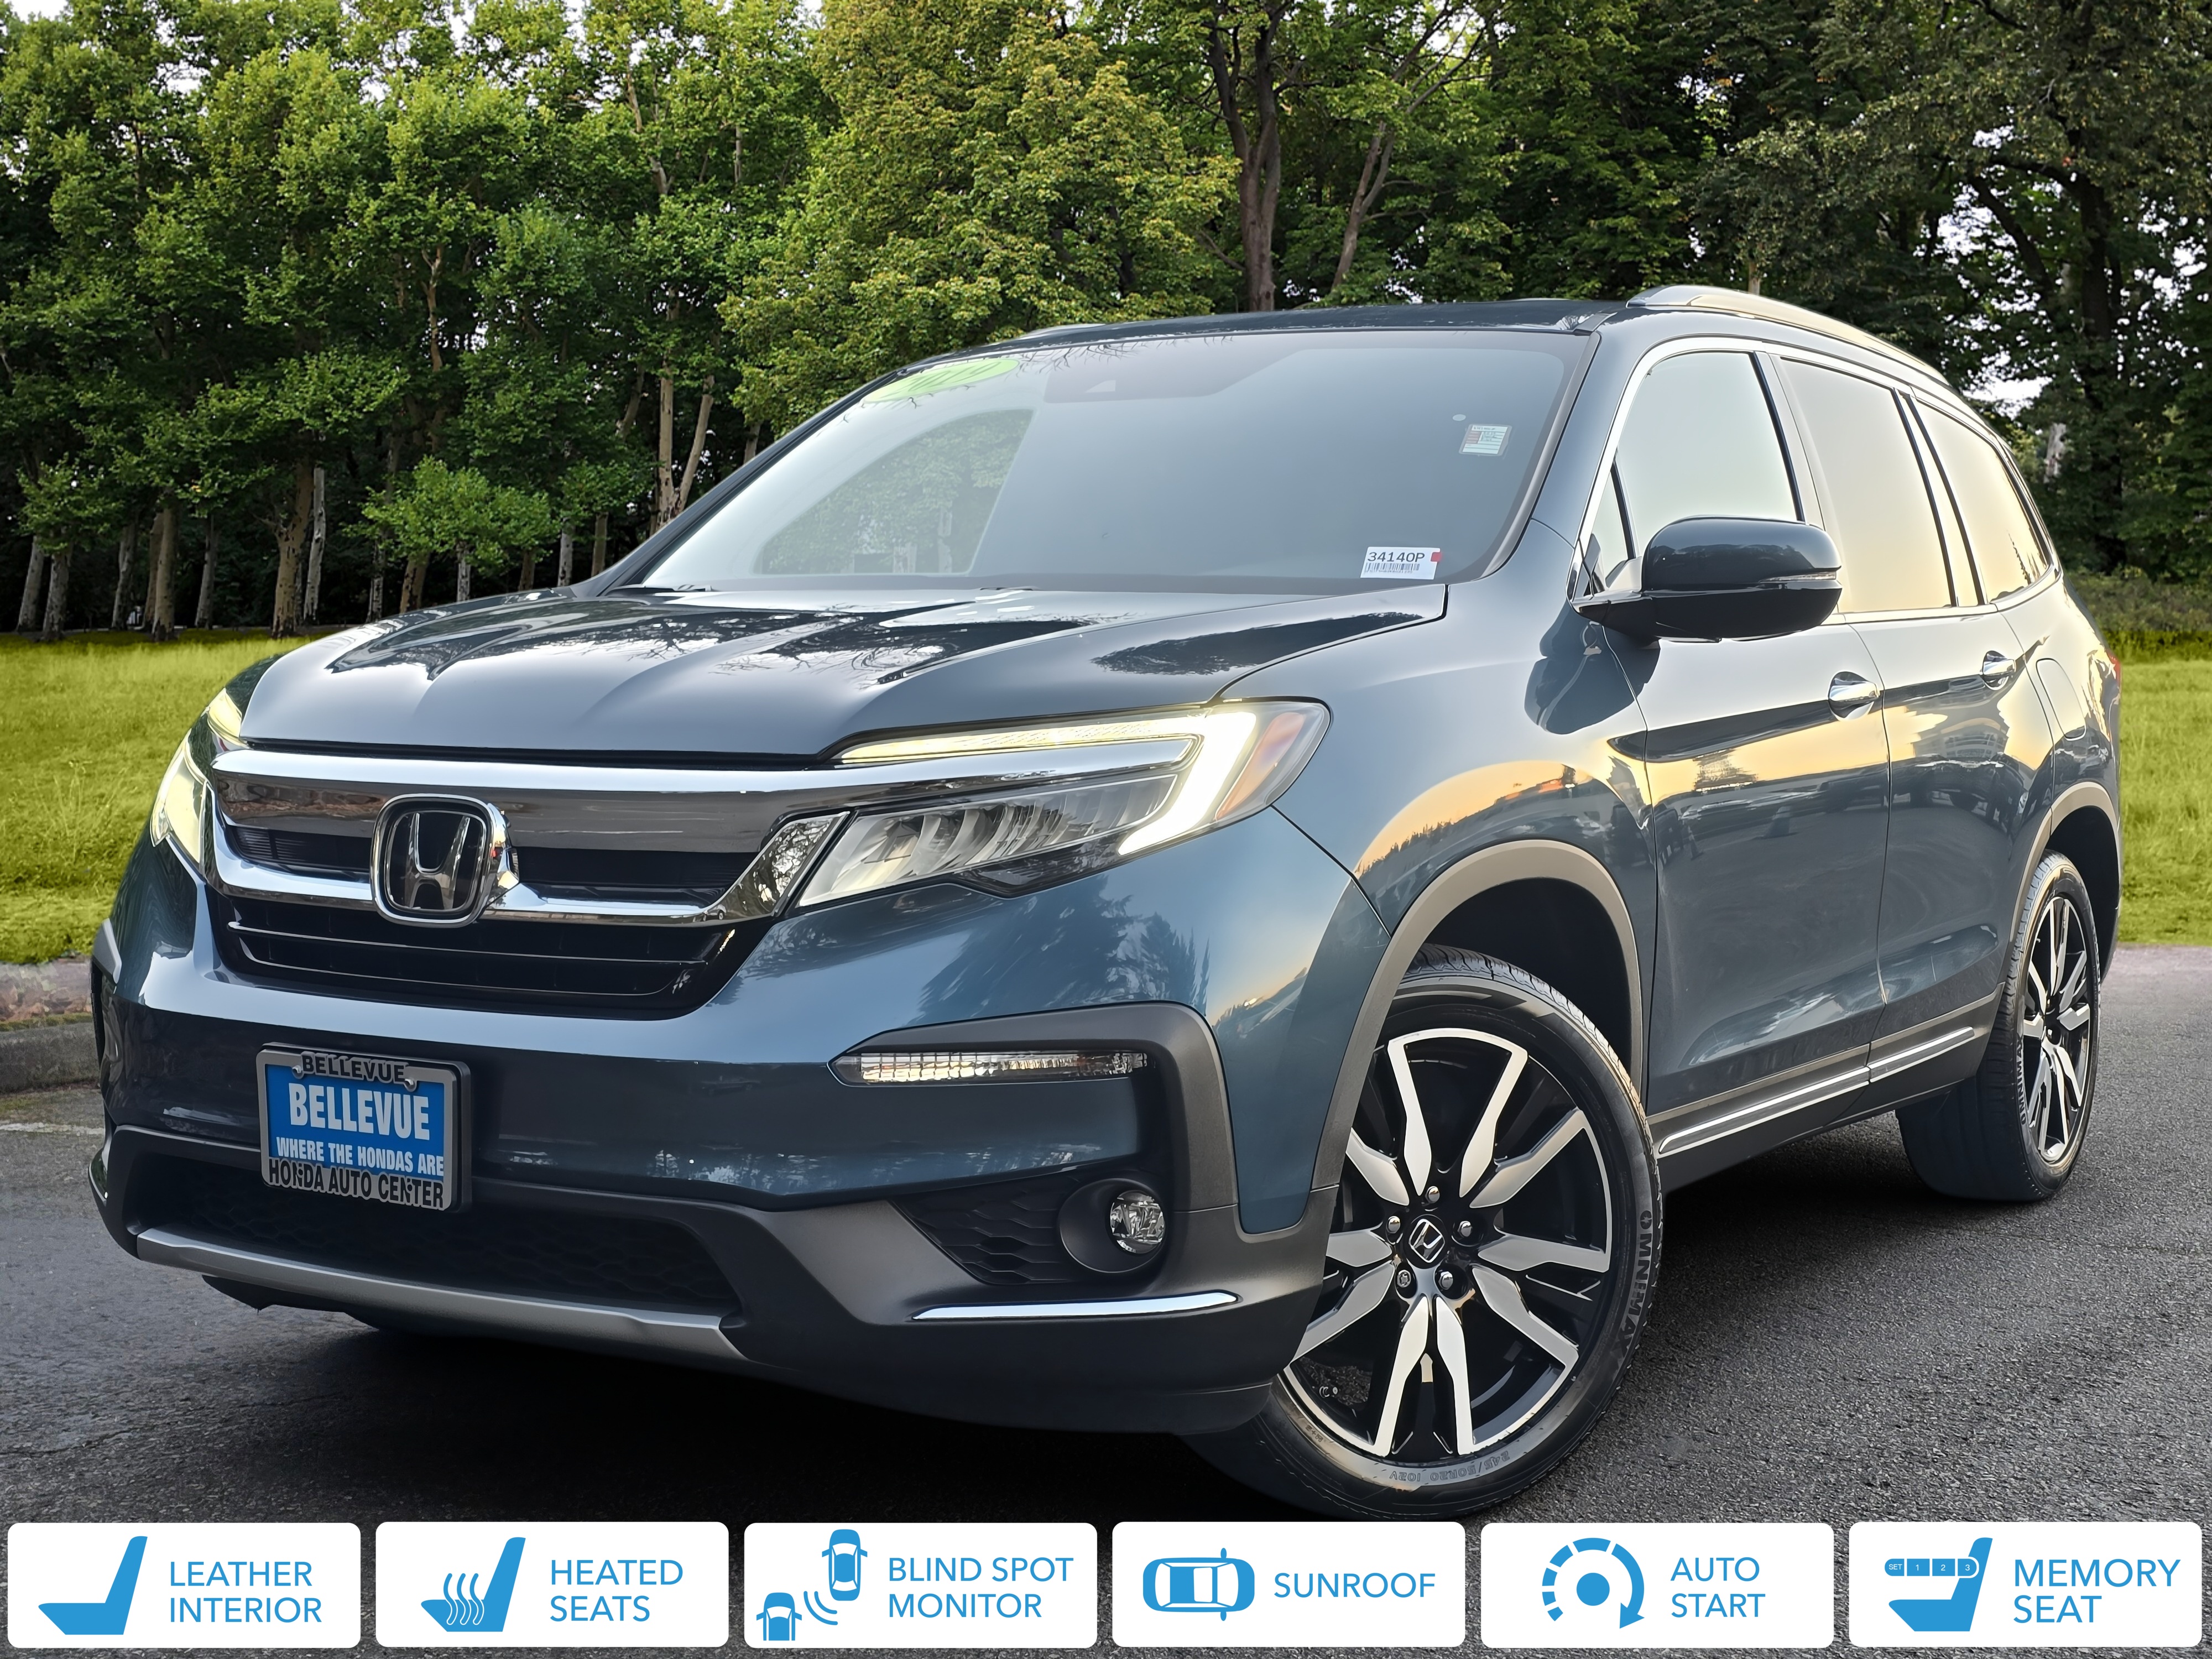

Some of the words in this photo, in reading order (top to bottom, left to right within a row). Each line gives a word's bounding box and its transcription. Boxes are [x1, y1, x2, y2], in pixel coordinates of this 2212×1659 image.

[879, 361, 1001, 399] 2019
[1368, 552, 1425, 562] 34140P
[302, 1055, 405, 1083] BELLEVUE
[2016, 1033, 2026, 1125] OMNIMAX
[289, 1083, 430, 1140] BELLEVUE
[276, 1136, 324, 1162] WHERE
[328, 1142, 353, 1165] THE
[357, 1146, 413, 1173] HONDAS
[418, 1153, 444, 1177] ARE
[269, 1159, 324, 1191] HONDA
[328, 1168, 372, 1197] AUTO
[378, 1173, 444, 1208] CENTER
[1614, 1210, 1652, 1355] OMNIMAX
[1389, 1470, 1421, 1482] 102V
[1430, 1451, 1511, 1481] 245/50R20
